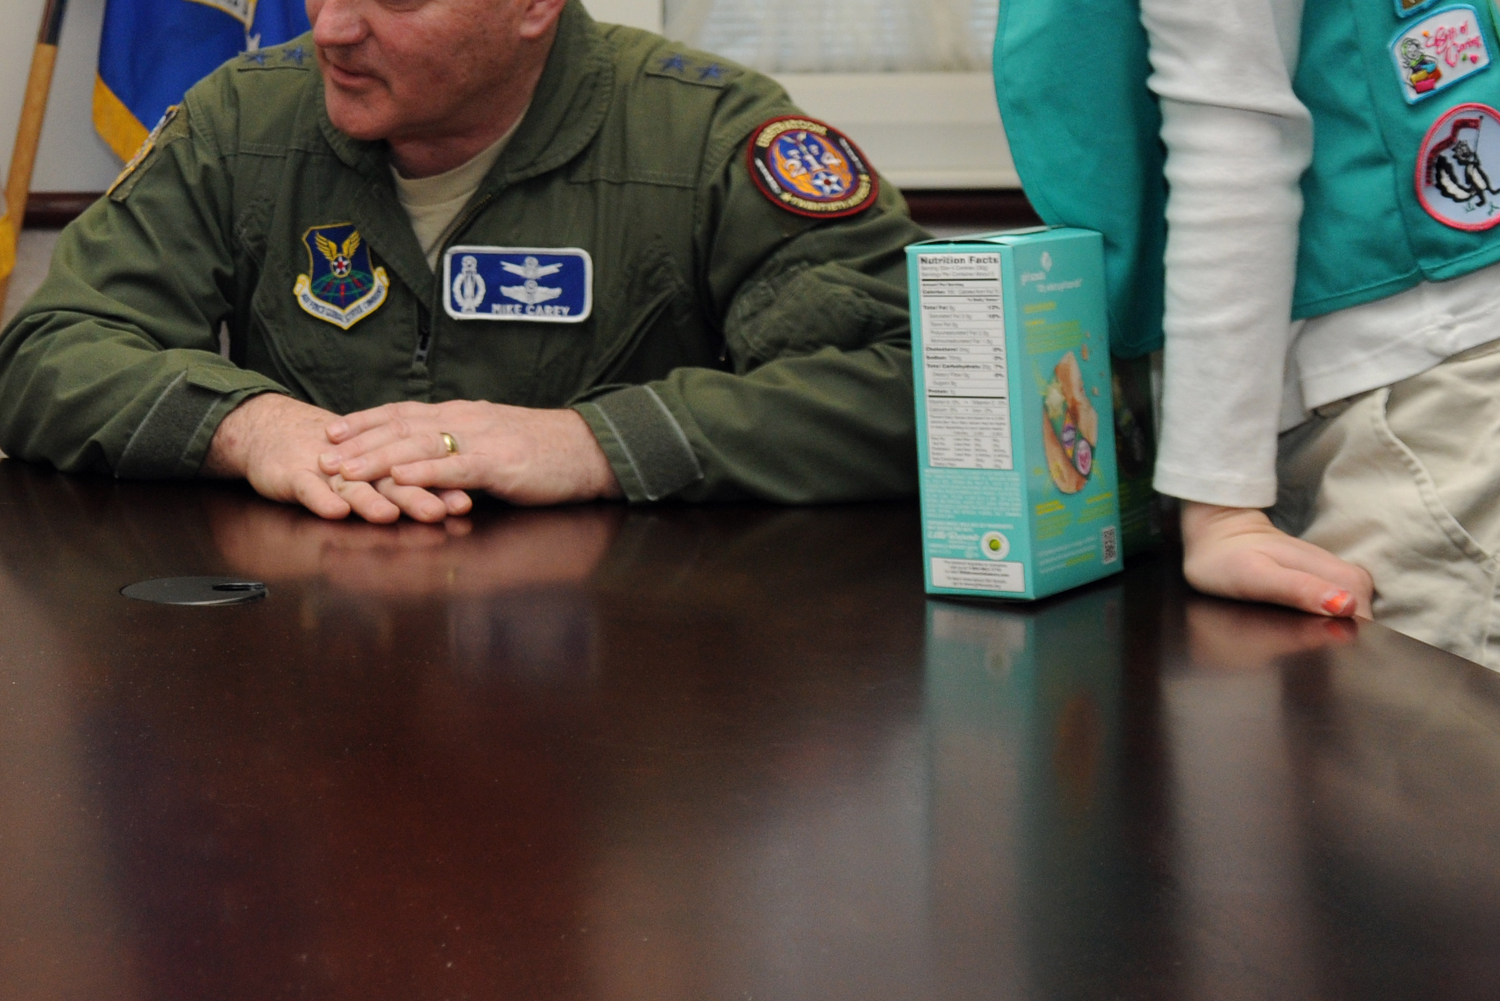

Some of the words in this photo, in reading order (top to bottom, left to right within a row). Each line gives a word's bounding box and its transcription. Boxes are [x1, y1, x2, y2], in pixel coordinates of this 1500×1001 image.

[969, 256, 999, 264] Facts
[491, 303, 522, 314] MIKE
[525, 305, 570, 316] CAREY
